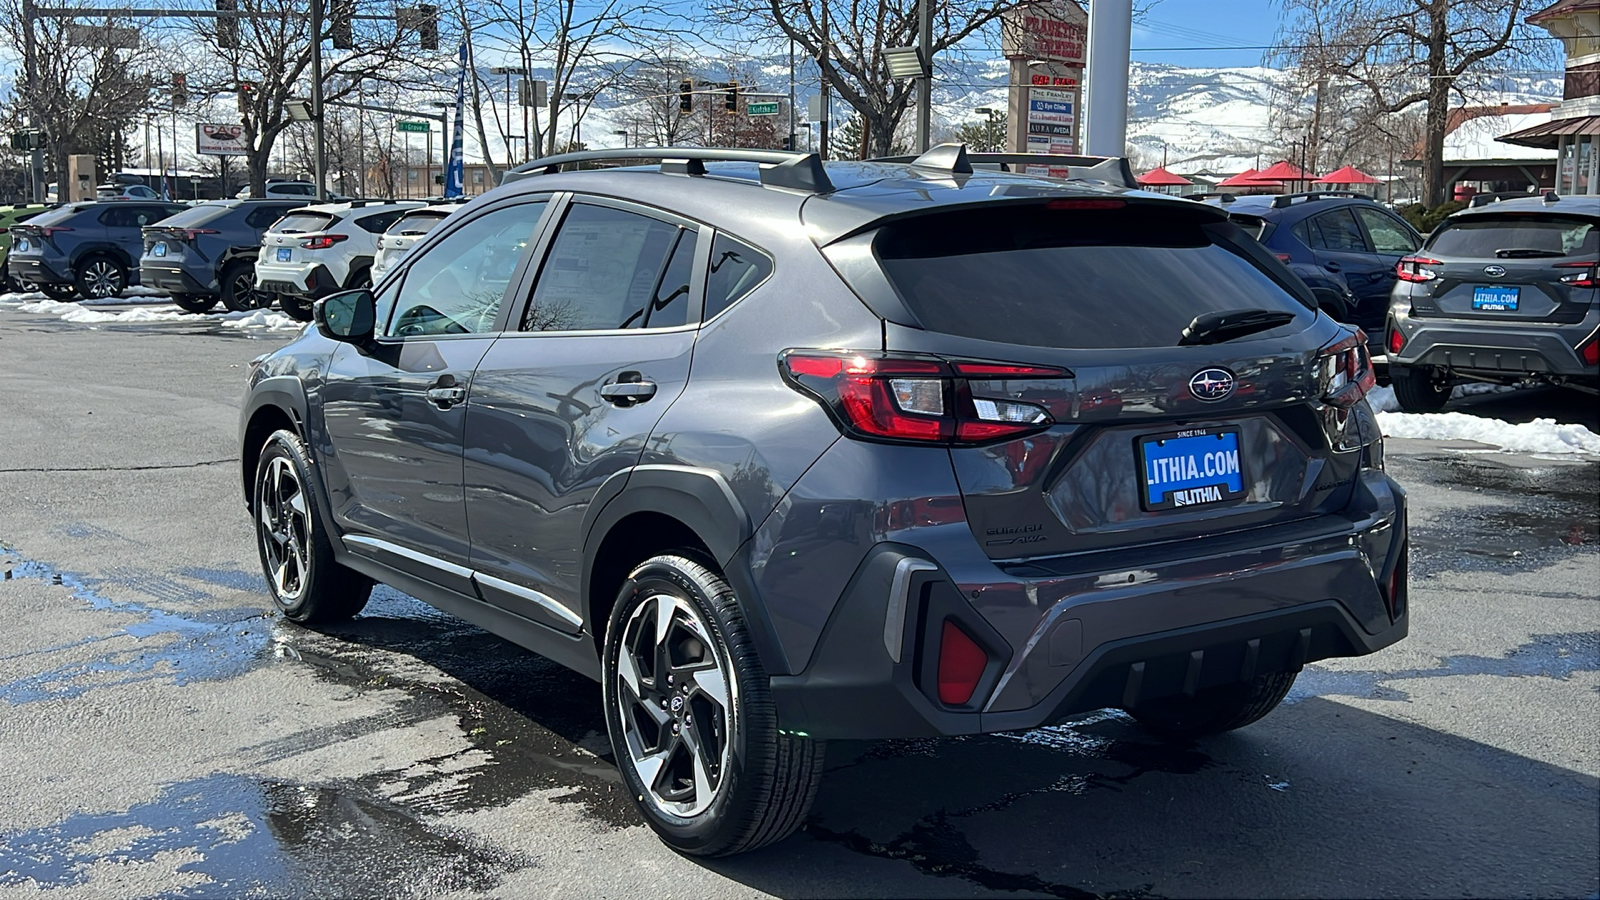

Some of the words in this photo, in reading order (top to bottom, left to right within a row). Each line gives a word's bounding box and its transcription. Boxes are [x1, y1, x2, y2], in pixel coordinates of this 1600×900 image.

[1032, 74, 1050, 85] CAR
[1044, 102, 1053, 110] Eye
[1053, 103, 1067, 111] Clinic
[203, 125, 242, 135] CAC
[407, 123, 423, 131] Grove
[1031, 125, 1050, 133] AURA
[1473, 293, 1518, 304] LITHIA.COM
[1177, 430, 1193, 439] SINCE
[1193, 428, 1207, 437] 1946
[1147, 449, 1240, 486] LITHIA.COM
[1184, 486, 1223, 506] LITHIA
[985, 523, 1044, 536] SUBARU
